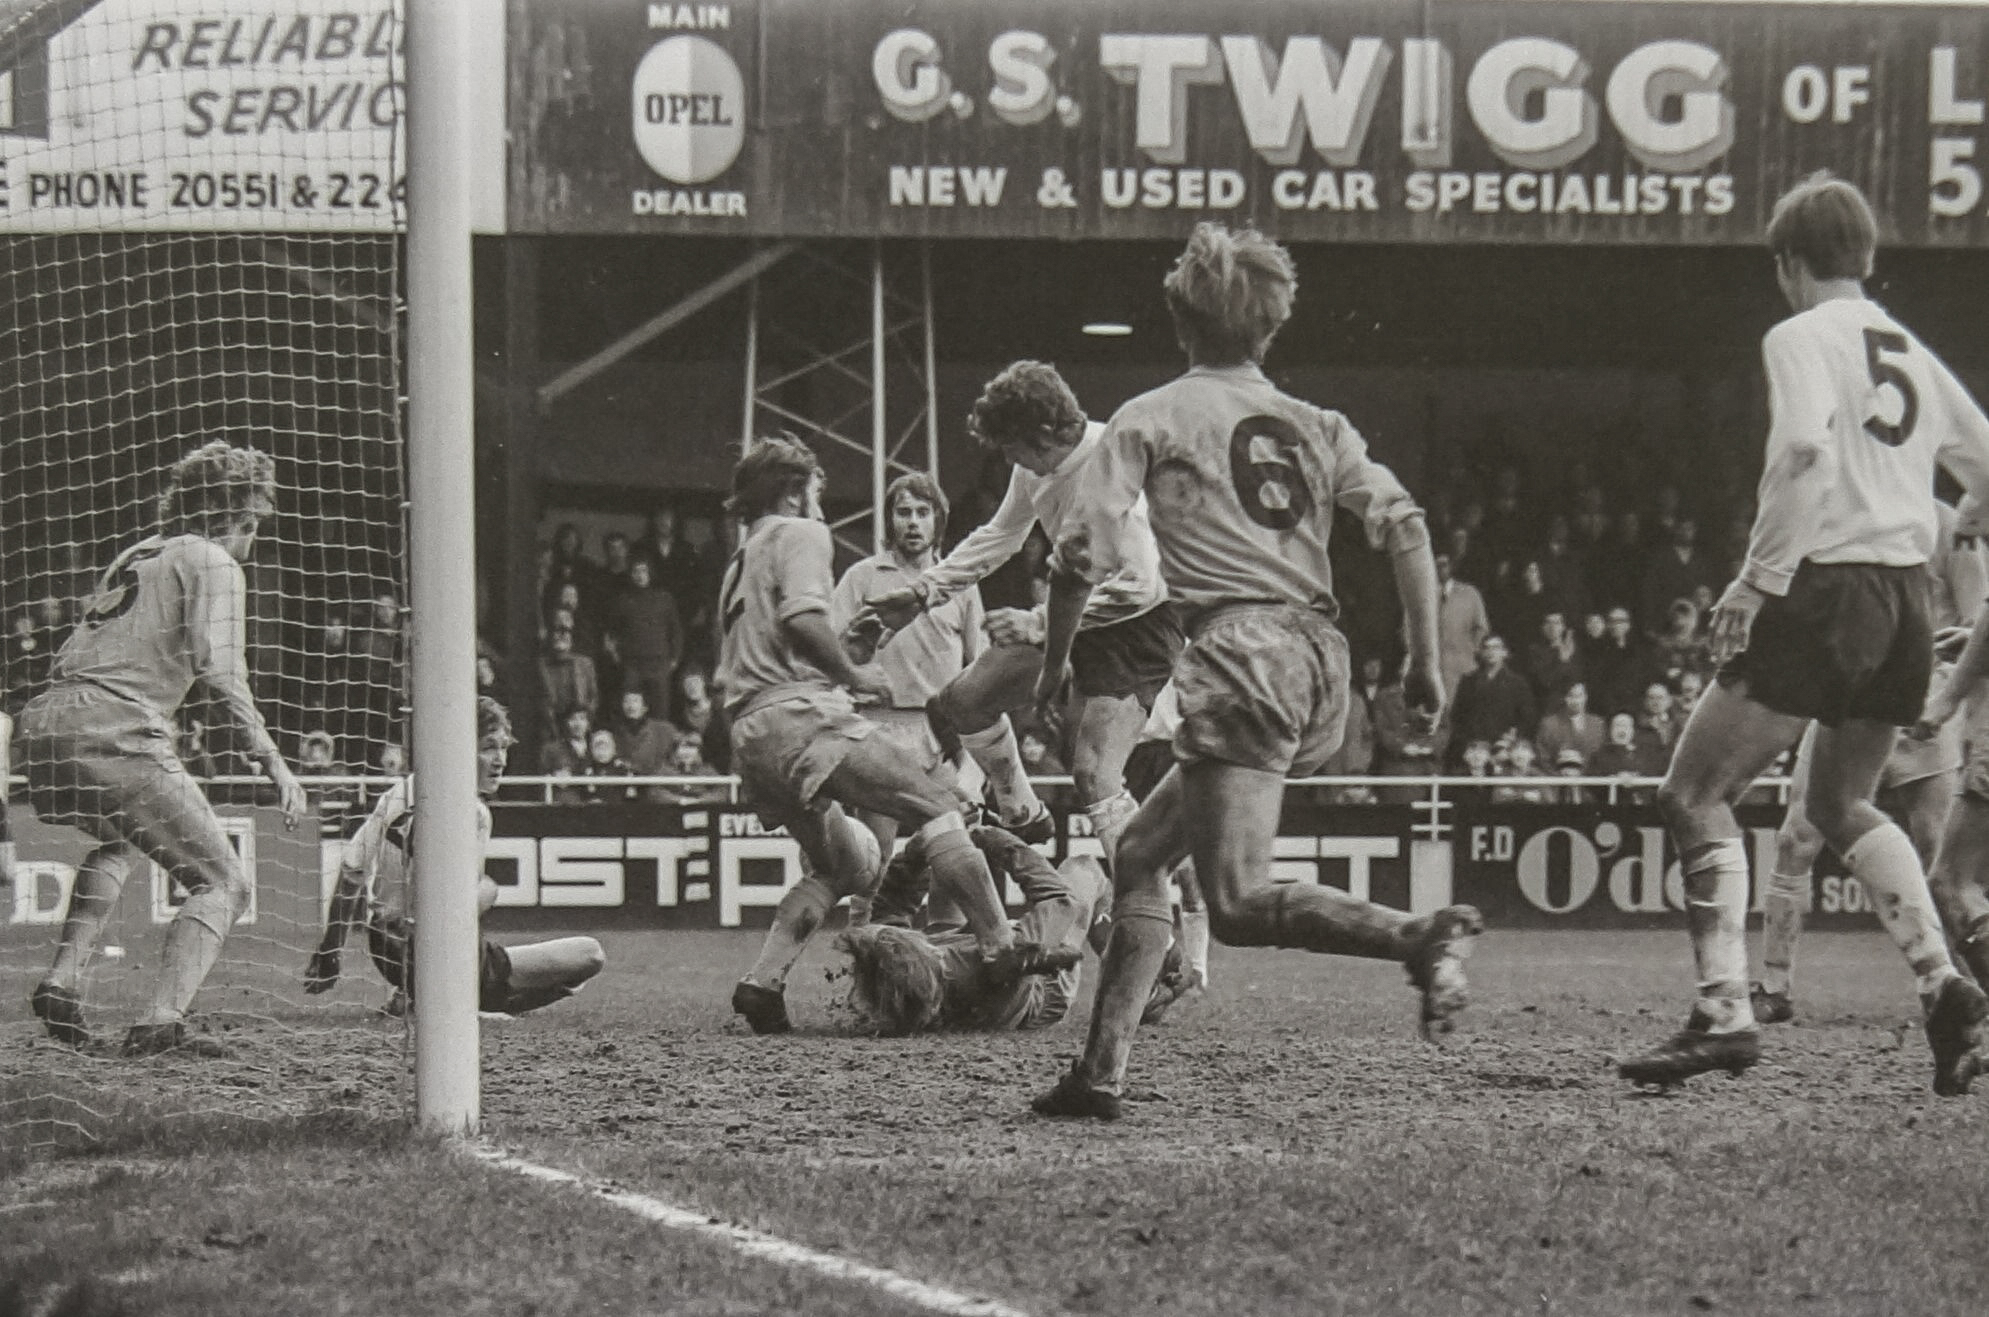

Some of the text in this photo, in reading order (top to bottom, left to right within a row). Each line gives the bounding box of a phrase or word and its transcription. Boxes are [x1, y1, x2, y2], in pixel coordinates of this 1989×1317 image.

[132, 9, 406, 71] RELIABL
[647, 4, 730, 29] MAIN
[183, 82, 406, 138] SERVIC
[644, 93, 733, 127] OPEL
[1100, 34, 1736, 172] TWIGG
[1781, 65, 1870, 123] OF
[29, 172, 148, 208] PHONE
[290, 174, 318, 208] &
[632, 190, 747, 217] DEALER
[888, 165, 1735, 214] NEW & USED CAR SPECIALISTS
[1863, 326, 1919, 447] 5
[1230, 414, 1315, 531] 6
